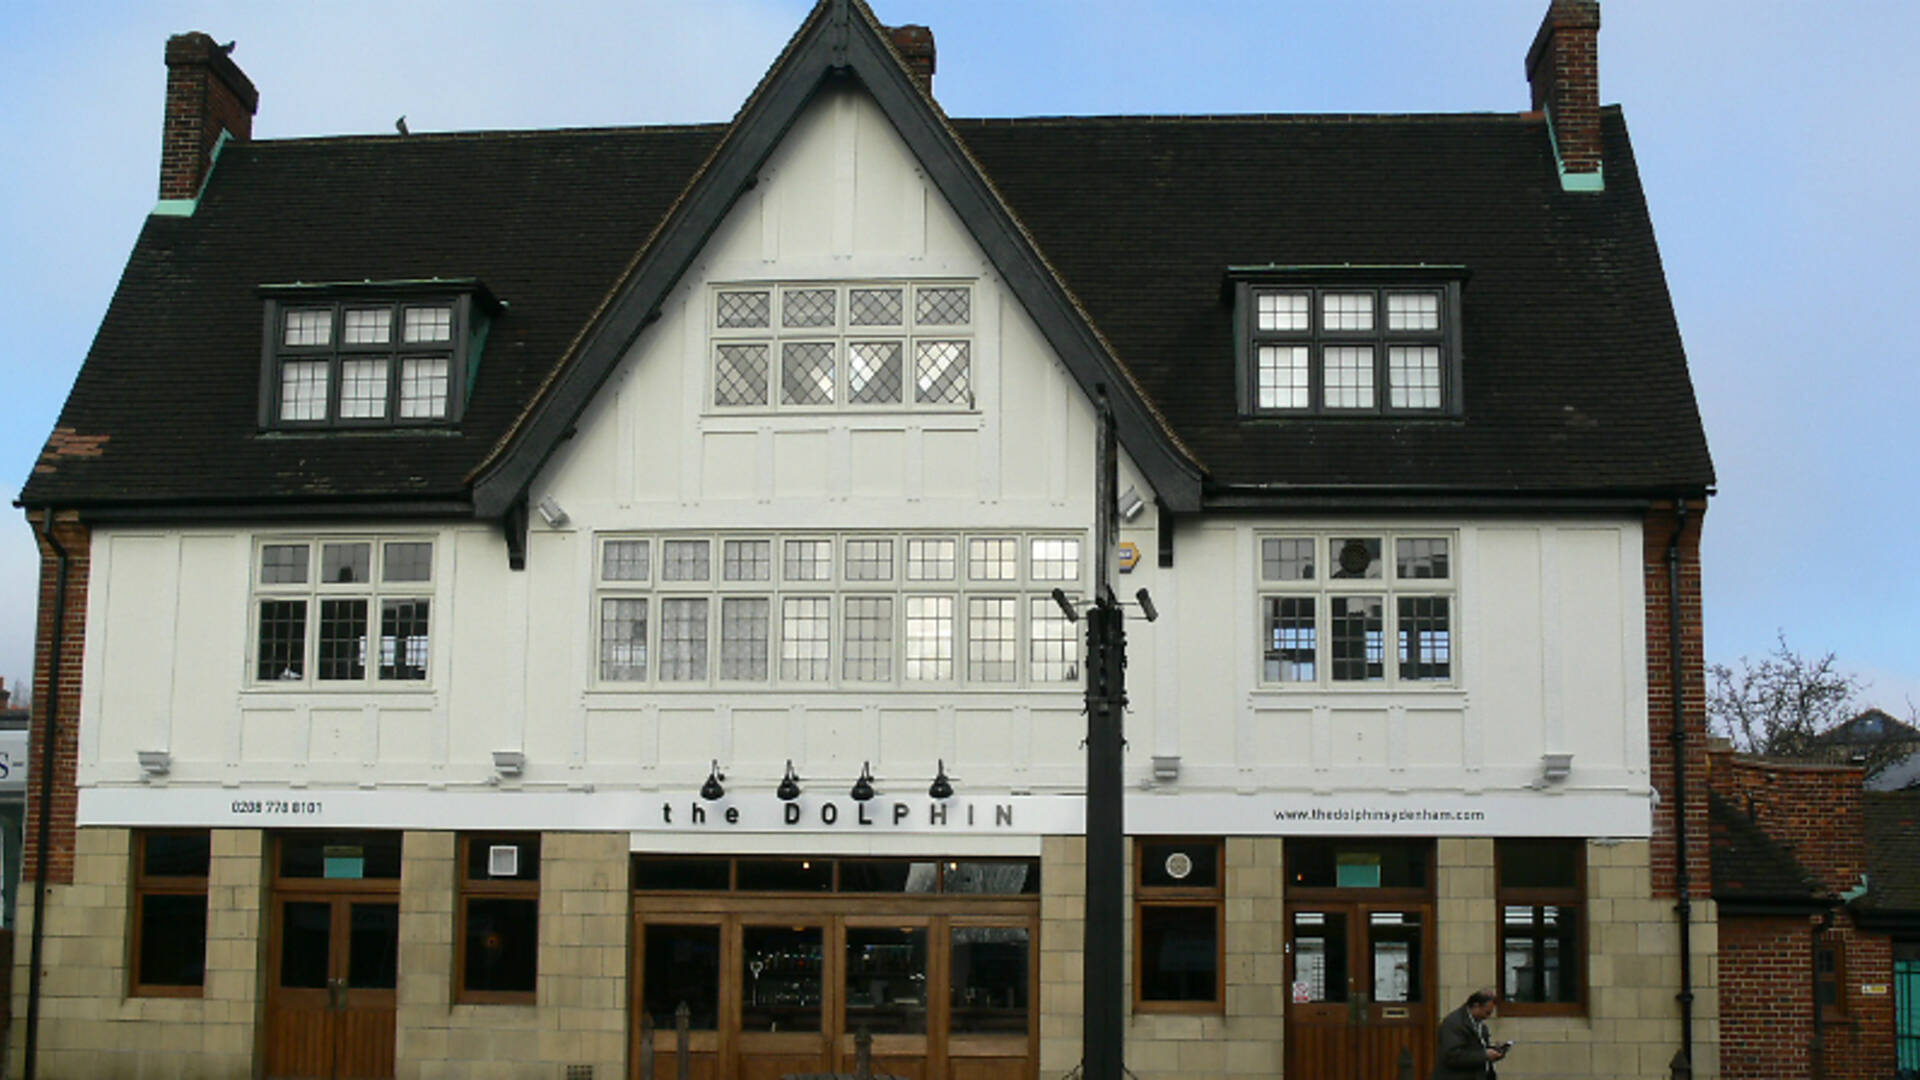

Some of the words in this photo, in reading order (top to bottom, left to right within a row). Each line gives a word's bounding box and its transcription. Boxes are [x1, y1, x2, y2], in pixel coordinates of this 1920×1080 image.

[663, 803, 739, 824] the
[784, 803, 1013, 826] DOLPHIN
[1274, 808, 1485, 823] www.thedolphinsydenham.com
